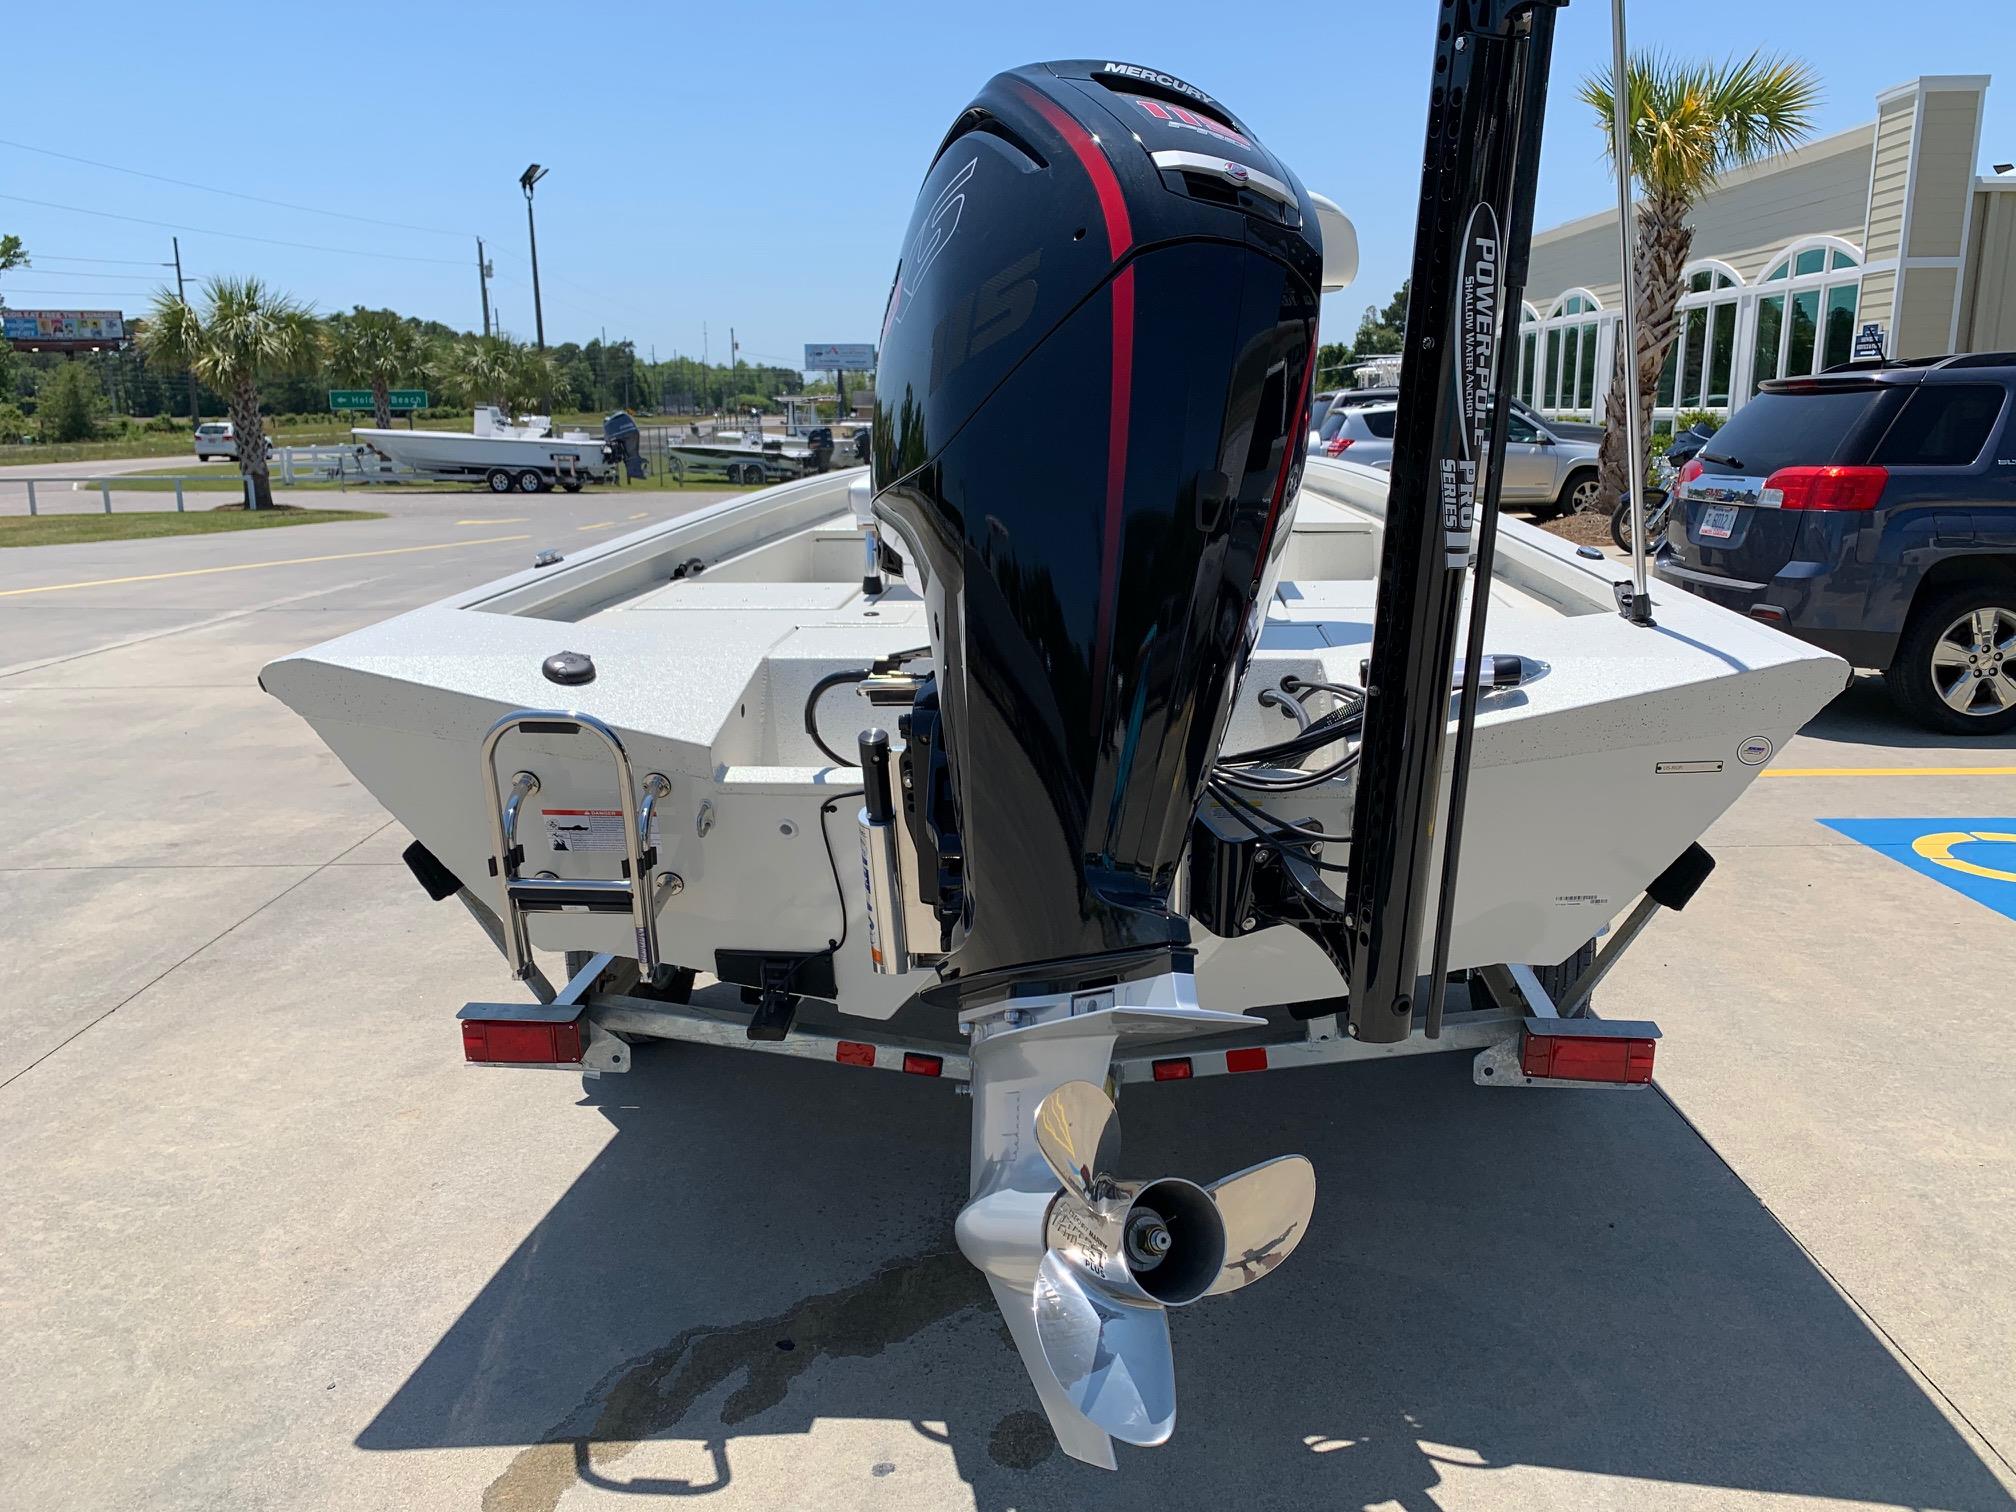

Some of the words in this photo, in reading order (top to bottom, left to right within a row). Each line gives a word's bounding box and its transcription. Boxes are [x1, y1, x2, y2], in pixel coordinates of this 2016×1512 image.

[1104, 62, 1215, 103] MERCURY
[1465, 276, 1475, 331] SHALLOW
[1465, 331, 1475, 371] WATER
[1474, 237, 1496, 447] POWER-POLE
[391, 396, 421, 405] Beach
[1465, 374, 1475, 418] ANCHOR
[1441, 458, 1458, 529] SERIES
[1459, 460, 1477, 529] PRO
[1085, 1258, 1106, 1279] PLUS
